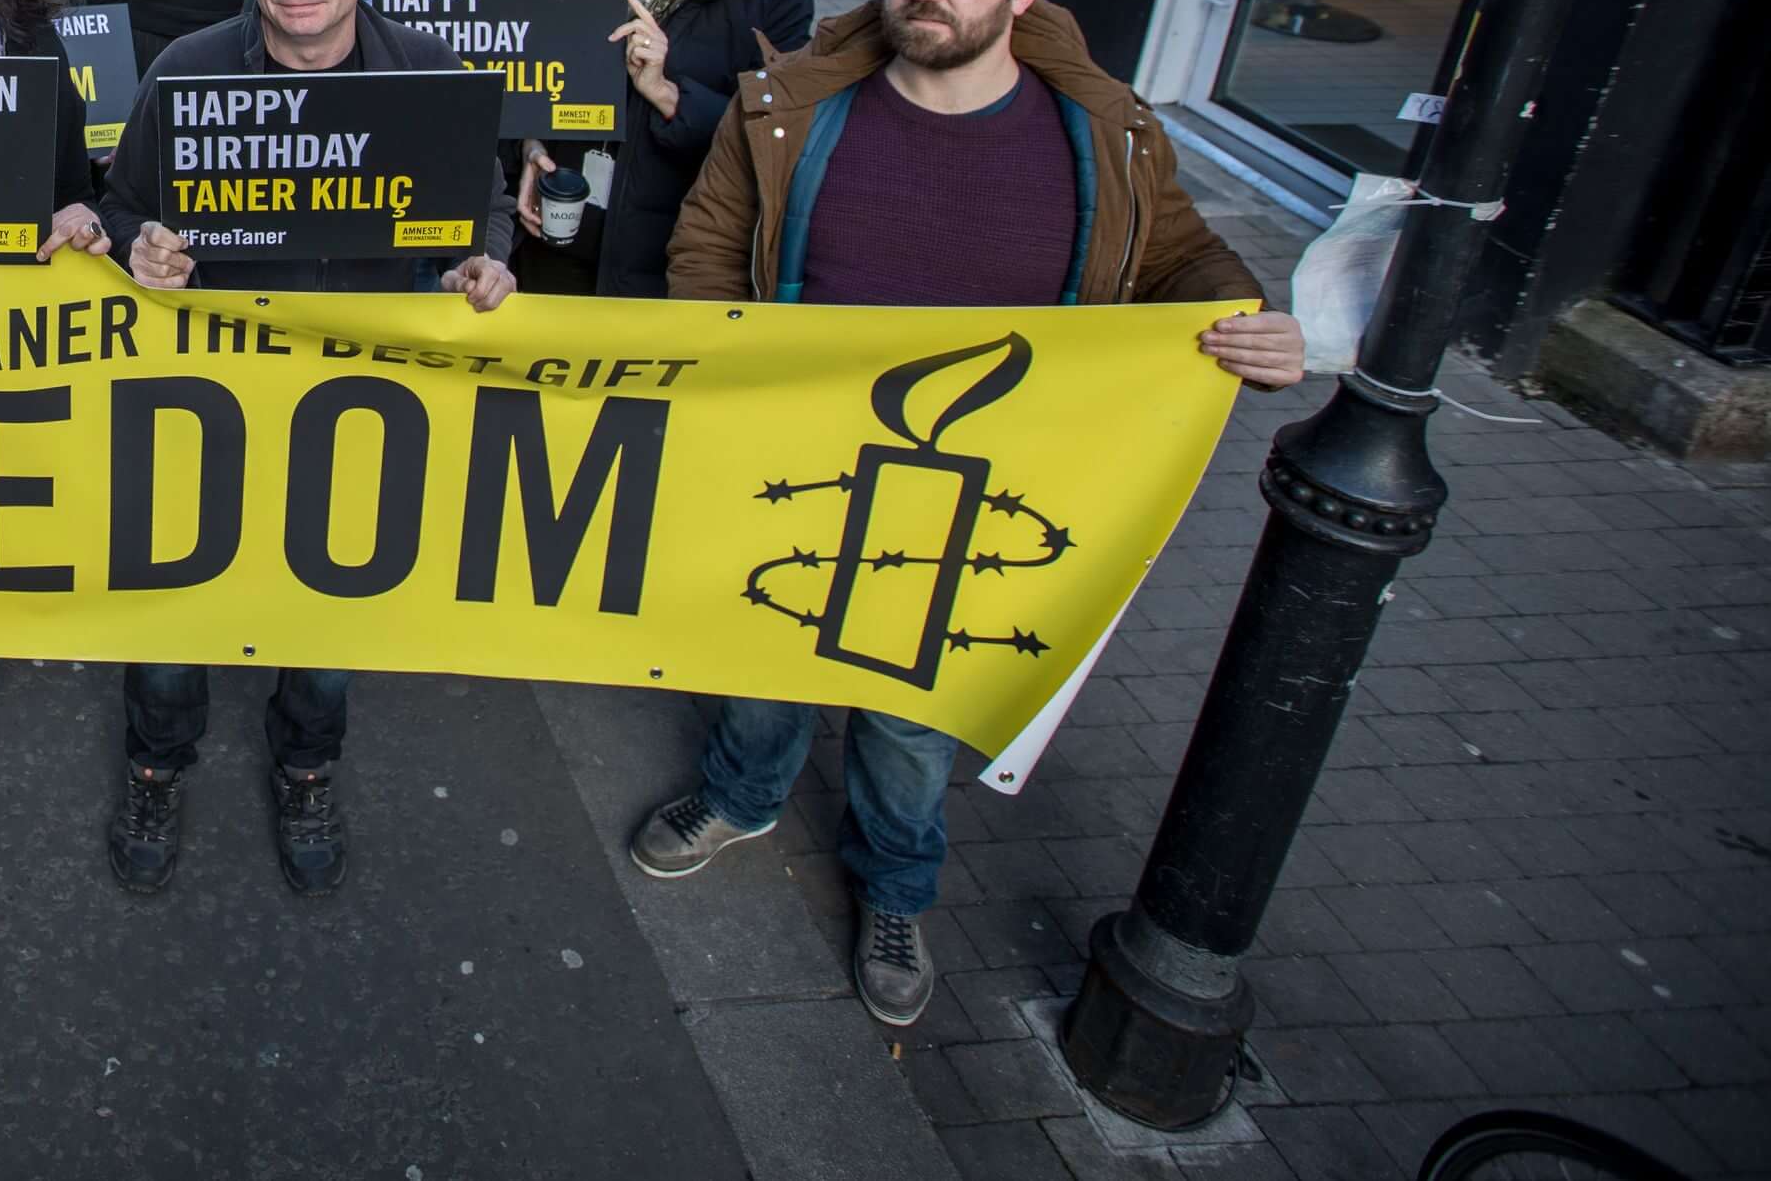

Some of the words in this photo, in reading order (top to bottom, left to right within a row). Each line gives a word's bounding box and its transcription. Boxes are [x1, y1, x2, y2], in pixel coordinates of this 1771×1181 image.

[51, 13, 110, 37] TANER
[173, 88, 308, 126] HAPPY
[559, 110, 591, 119] AMNESTY
[174, 133, 371, 171] BIRTHDAY
[172, 178, 296, 213] TANER
[311, 175, 413, 218] KILIÇ
[402, 226, 444, 236] AMNESTY
[525, 358, 699, 388] GIFT
